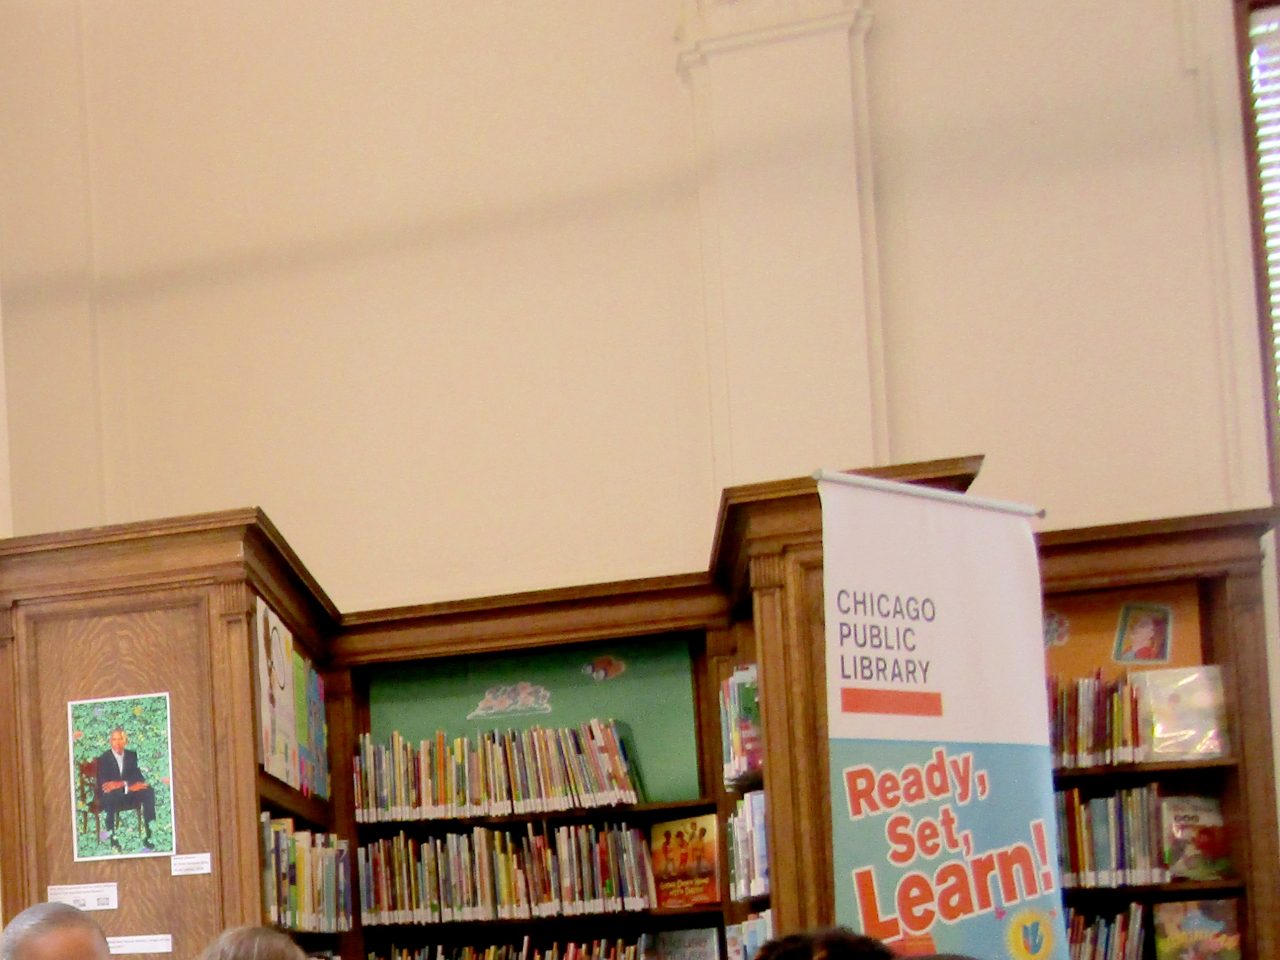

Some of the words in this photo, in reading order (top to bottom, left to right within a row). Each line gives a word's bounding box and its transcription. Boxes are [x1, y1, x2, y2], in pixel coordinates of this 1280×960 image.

[836, 589, 937, 623] CHICAGO
[839, 622, 917, 652] PUBLIC
[840, 655, 931, 685] LIBRARY
[844, 747, 988, 819] Ready,
[886, 807, 973, 866] Set,
[853, 818, 1054, 943] Learn!
